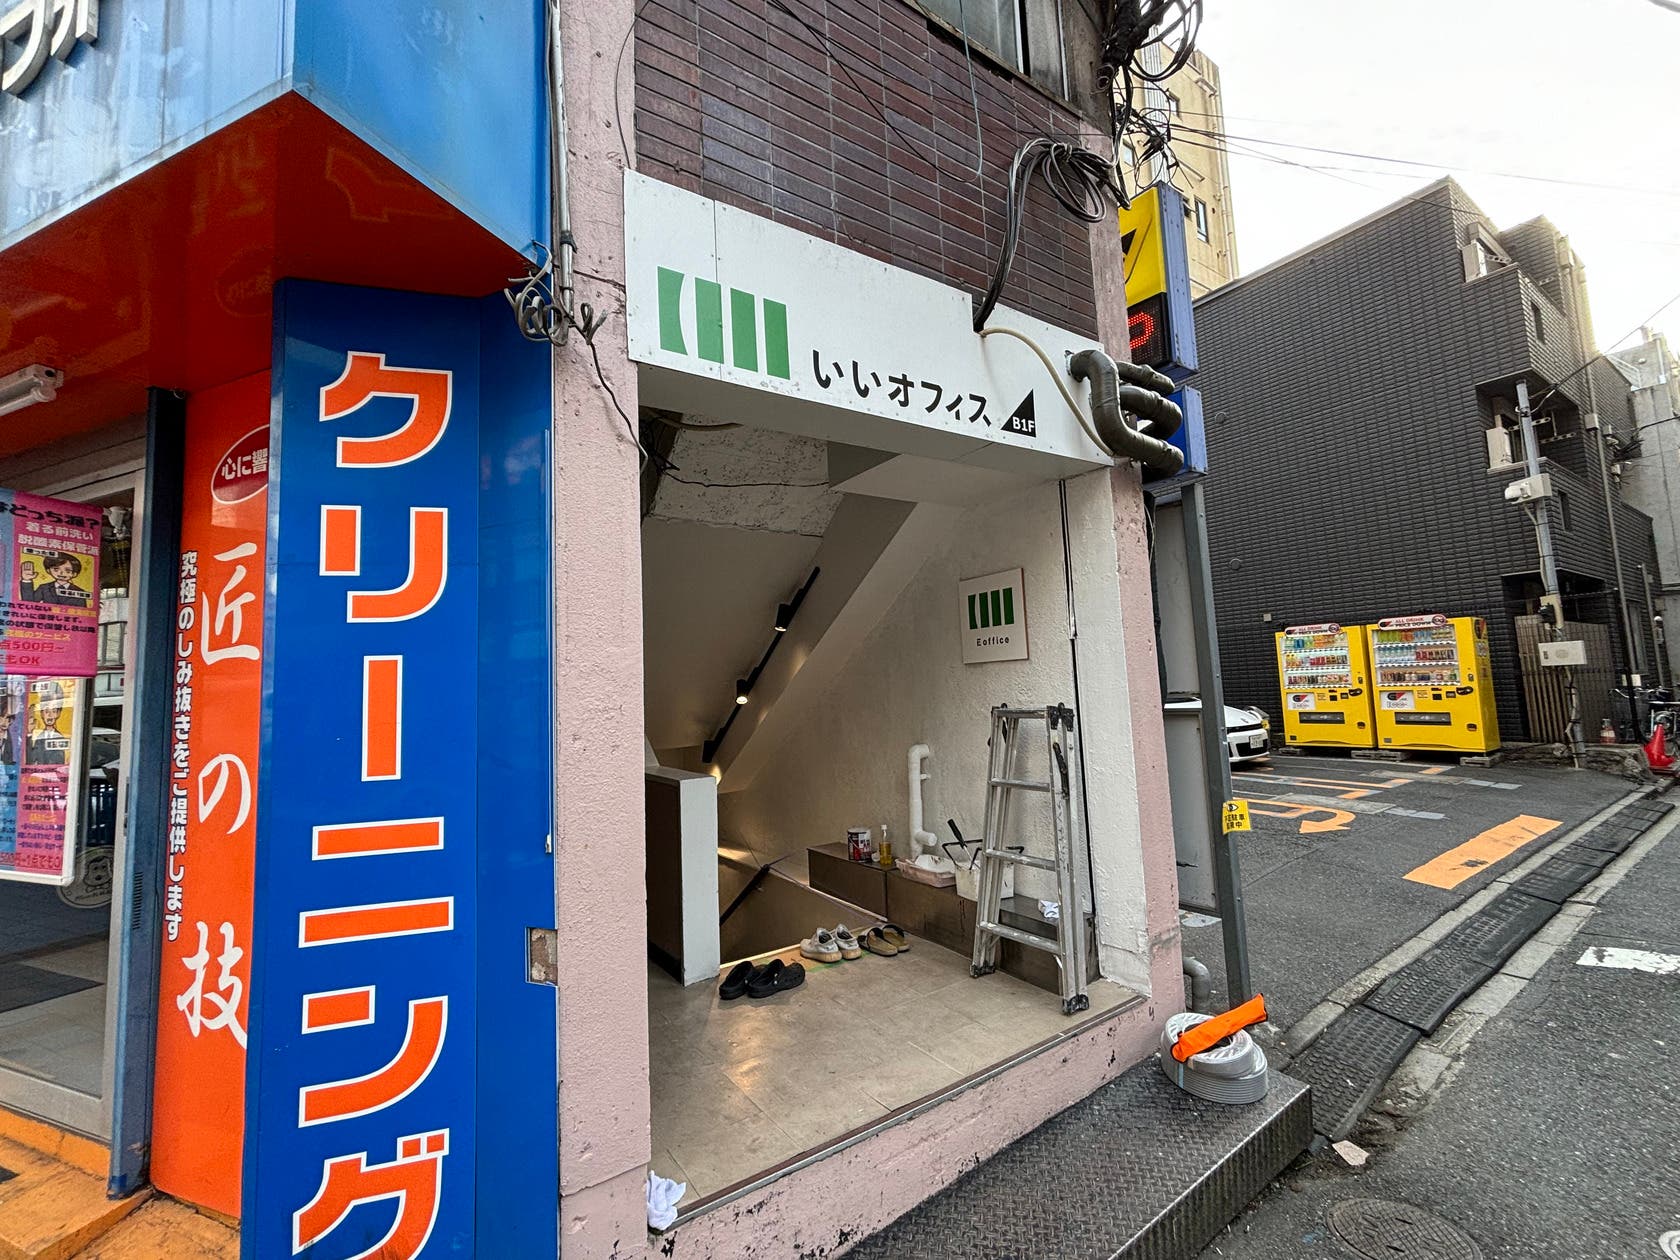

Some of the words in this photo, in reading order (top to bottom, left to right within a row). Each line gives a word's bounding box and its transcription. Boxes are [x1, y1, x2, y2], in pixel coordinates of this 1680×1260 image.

[812, 349, 992, 427] いいオフィス
[1012, 416, 1035, 433] B1F
[221, 448, 268, 480] 心に響
[976, 636, 1010, 647] Eoffice
[165, 551, 198, 942] 究極のしみ抜きをご提供します
[292, 351, 453, 1260] クリーニング
